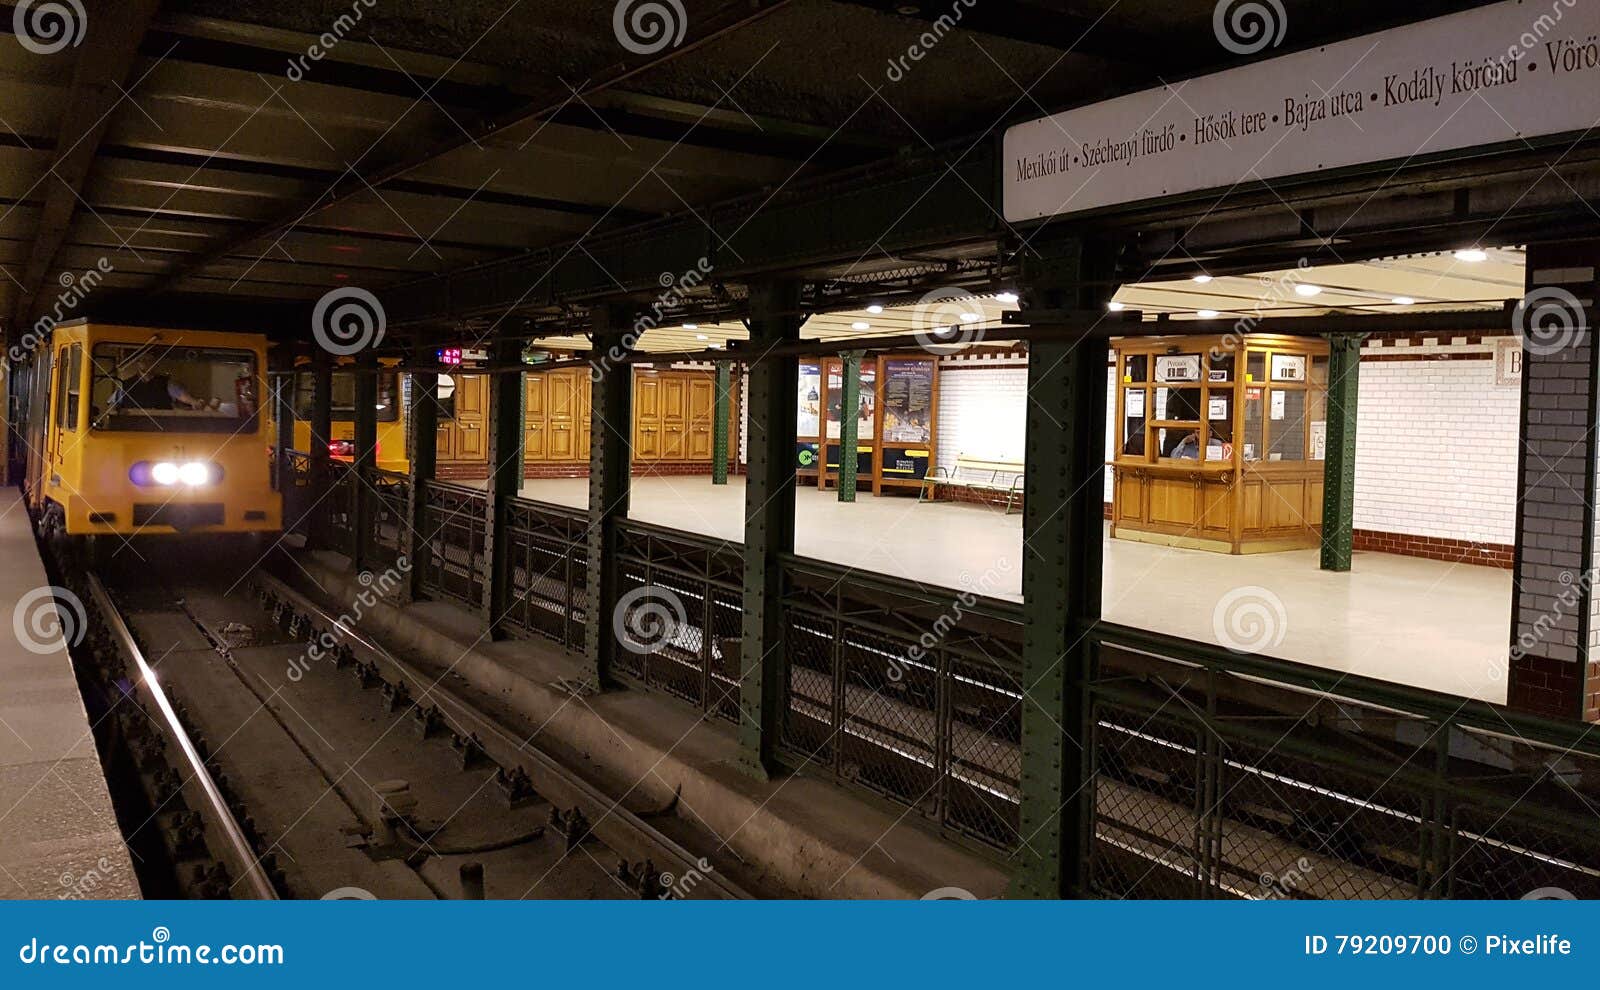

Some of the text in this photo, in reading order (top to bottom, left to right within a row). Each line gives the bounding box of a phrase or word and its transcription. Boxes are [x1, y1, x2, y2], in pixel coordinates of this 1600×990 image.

[1016, 35, 1600, 182] Mexikói út Széchenyi fürdő Hősök tere Bajza utca Kodály körönd Vörö
